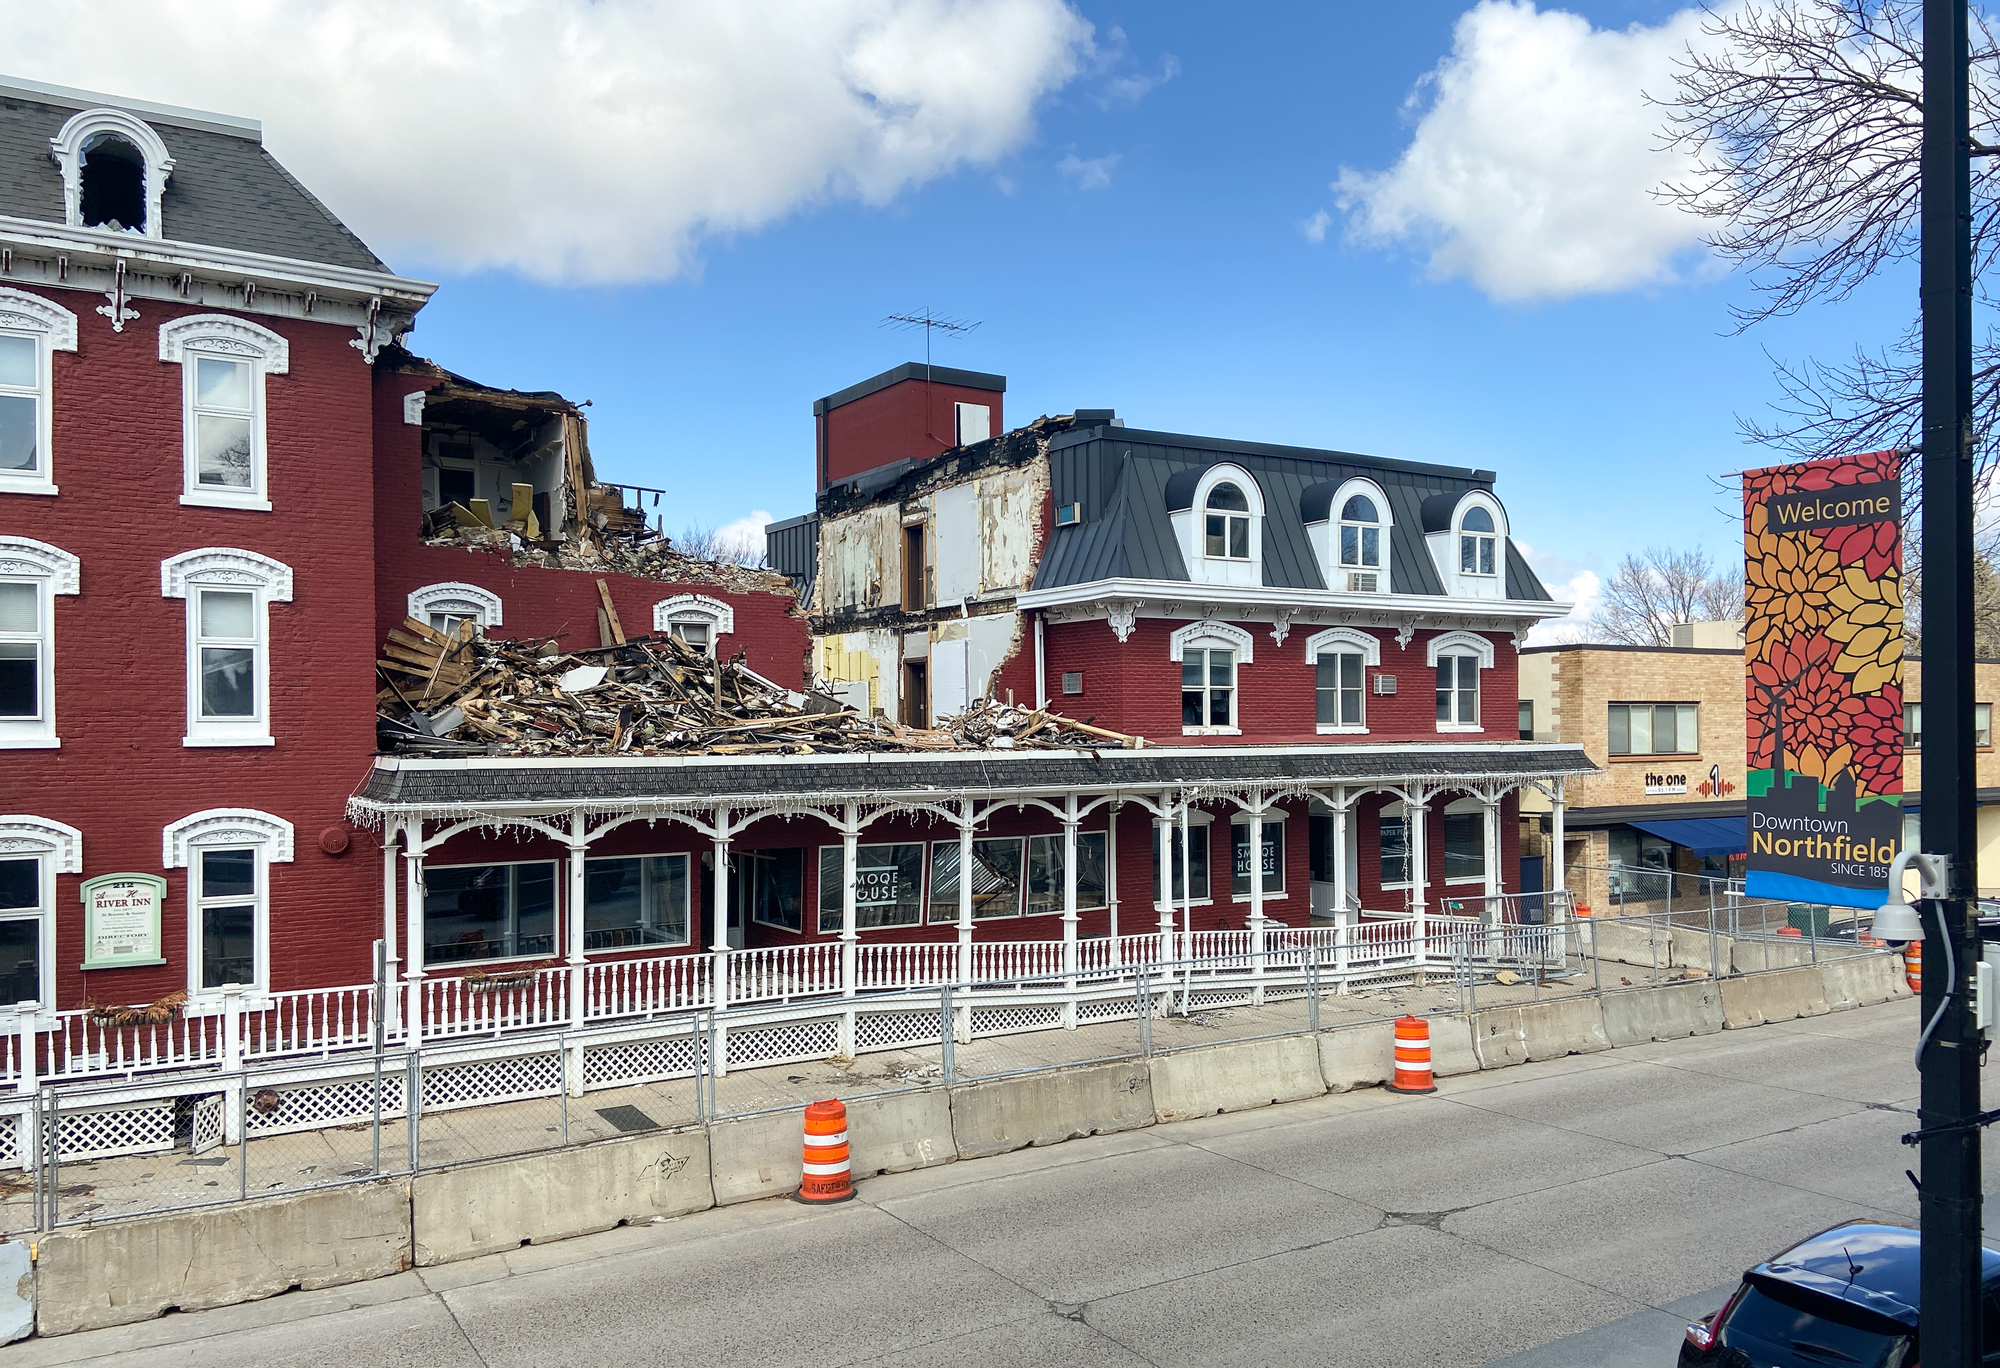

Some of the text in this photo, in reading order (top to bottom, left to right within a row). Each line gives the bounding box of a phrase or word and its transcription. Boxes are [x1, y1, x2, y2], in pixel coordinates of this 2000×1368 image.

[1777, 496, 1890, 524] Welcome
[1645, 772, 1686, 786] the one
[1752, 811, 1848, 833] Downtown
[1237, 847, 1274, 858] SMQE
[1752, 831, 1896, 865] Northfield
[1237, 858, 1274, 871] HOSE
[1831, 862, 1889, 879] SINCE 185
[856, 872, 898, 885] MOQE
[856, 885, 898, 900] OUSE
[96, 898, 151, 908] RIVER INN
